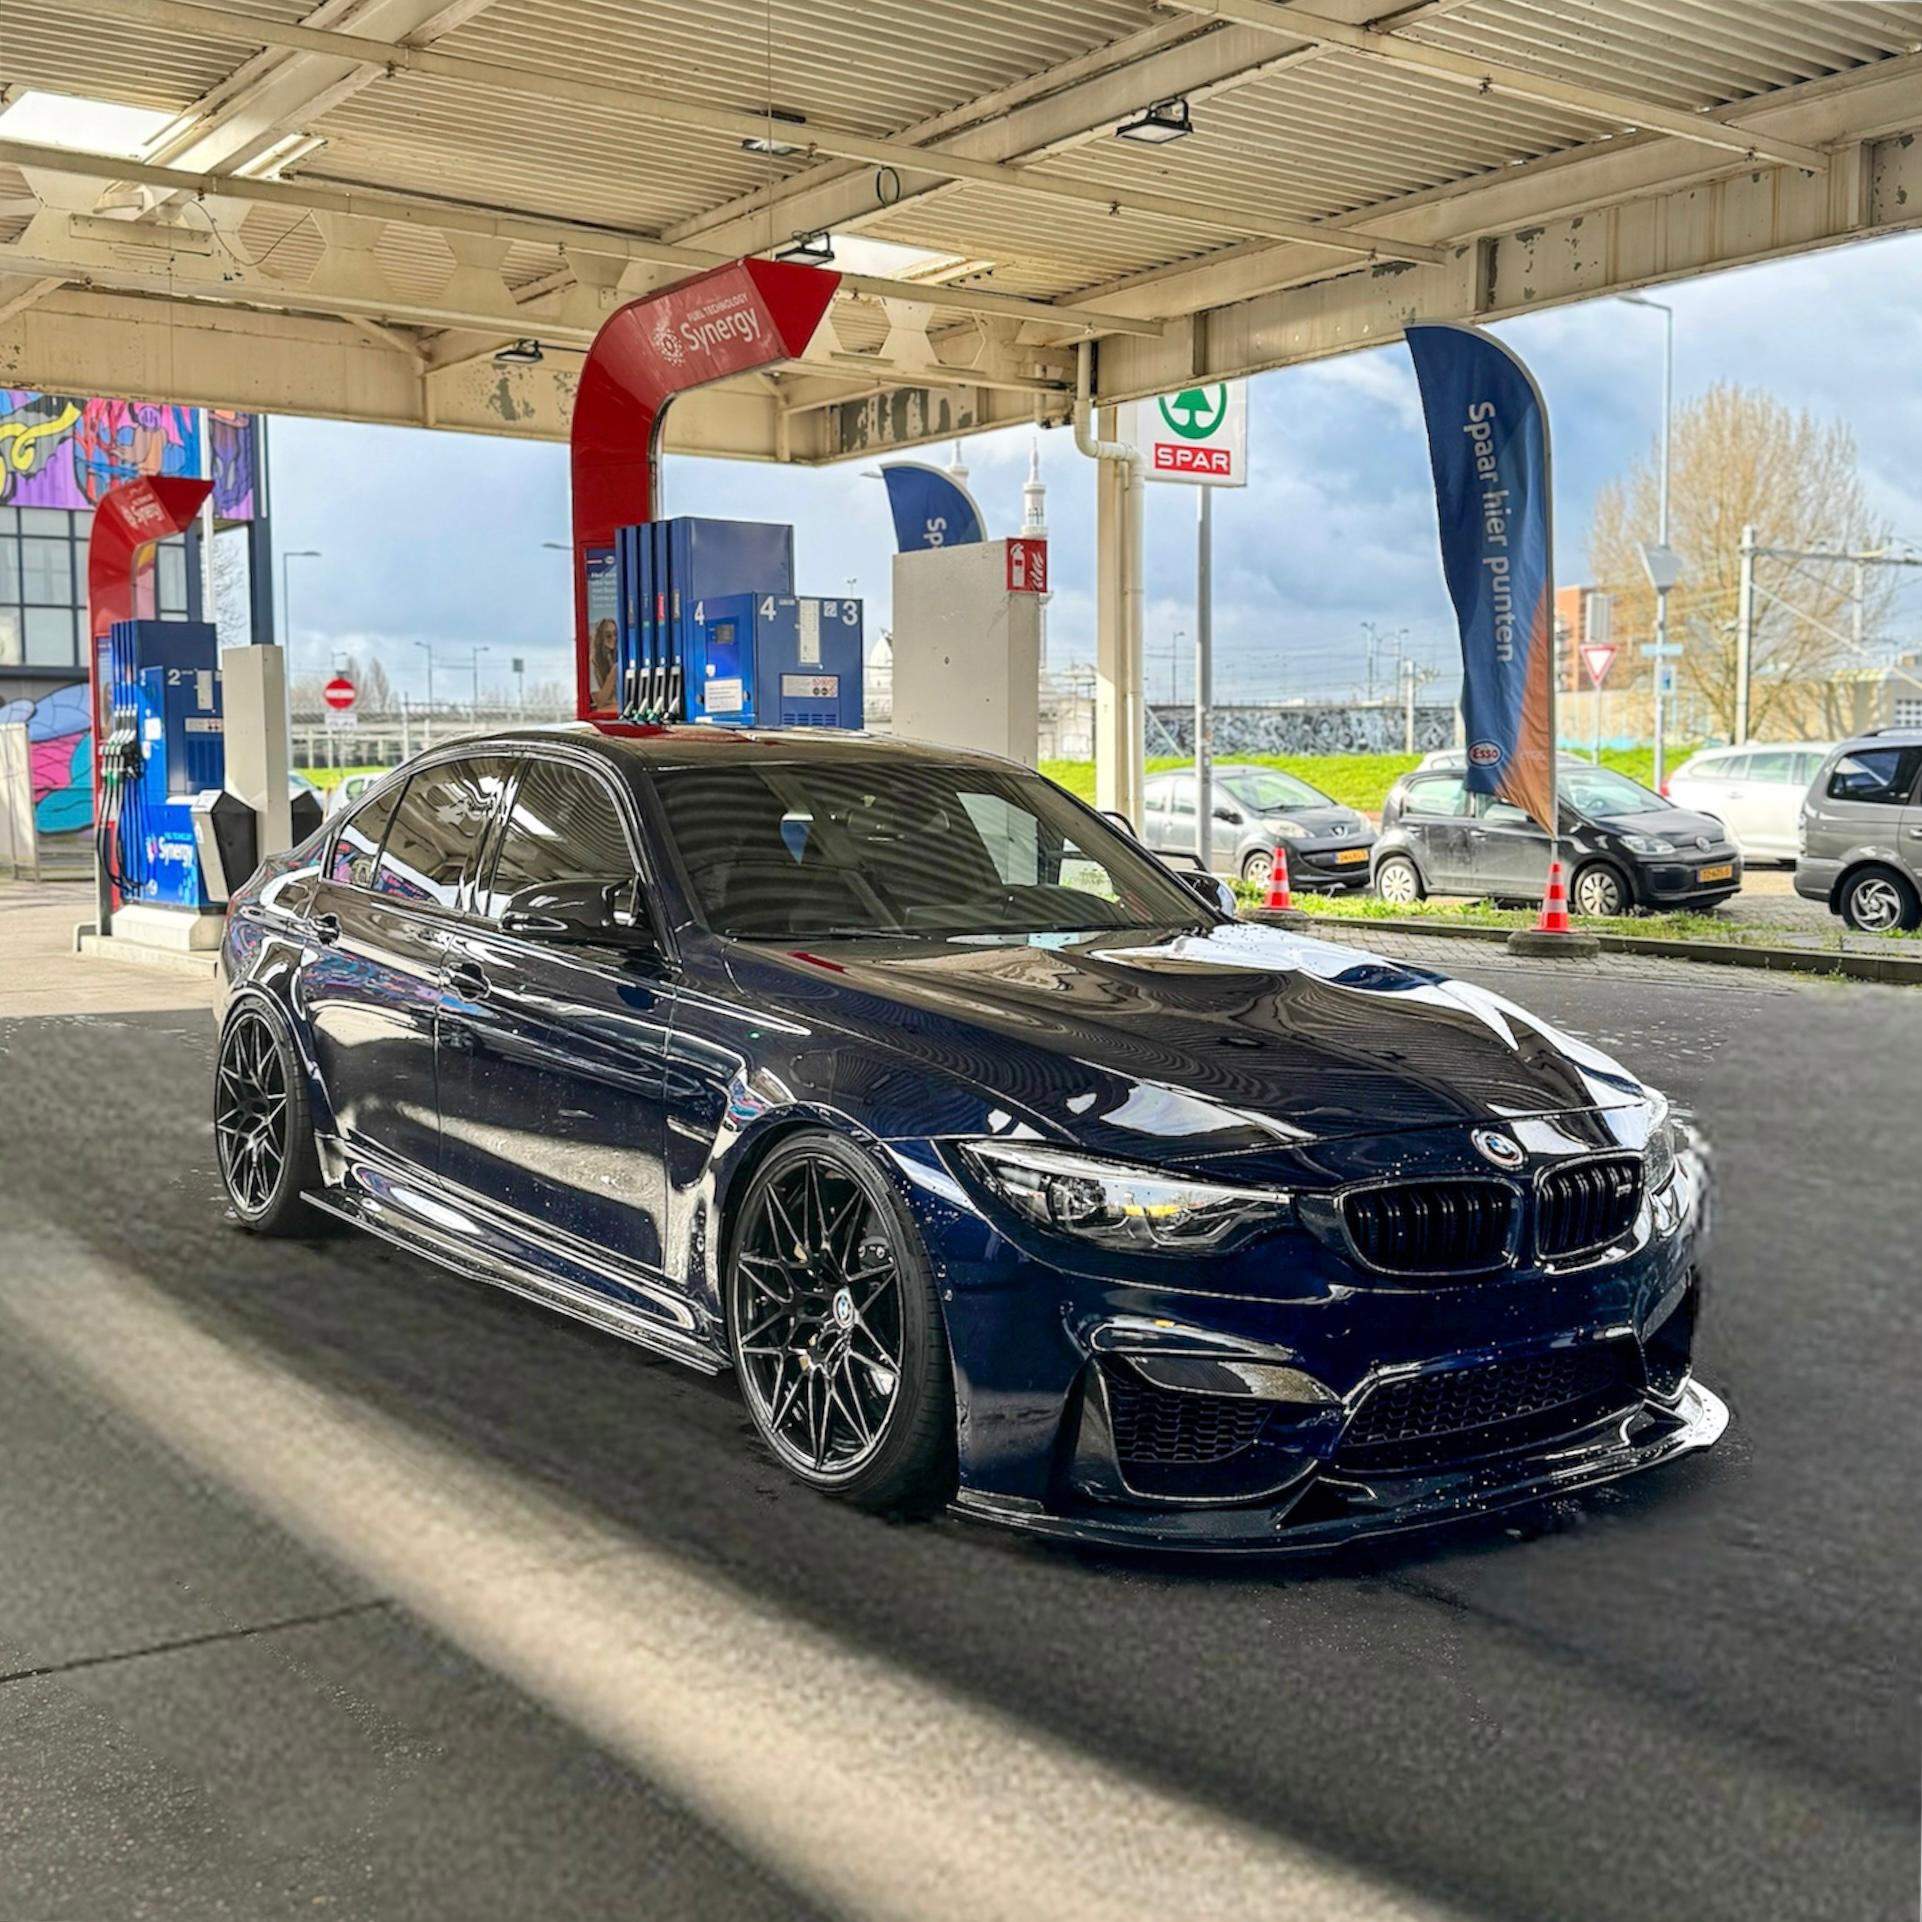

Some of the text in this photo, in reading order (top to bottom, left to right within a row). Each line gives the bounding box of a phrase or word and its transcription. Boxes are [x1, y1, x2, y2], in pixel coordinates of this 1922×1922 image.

[686, 293, 748, 322] FUEL TECHNOLOGY
[680, 308, 761, 356] Synergy
[1157, 447, 1229, 472] SPAR
[923, 517, 947, 549] Sp
[1463, 401, 1516, 662] Spaar hier punten
[694, 601, 705, 626] 4
[759, 596, 777, 621] 4
[842, 601, 858, 625] 3
[168, 668, 181, 686] 2
[1472, 747, 1498, 759] Esso
